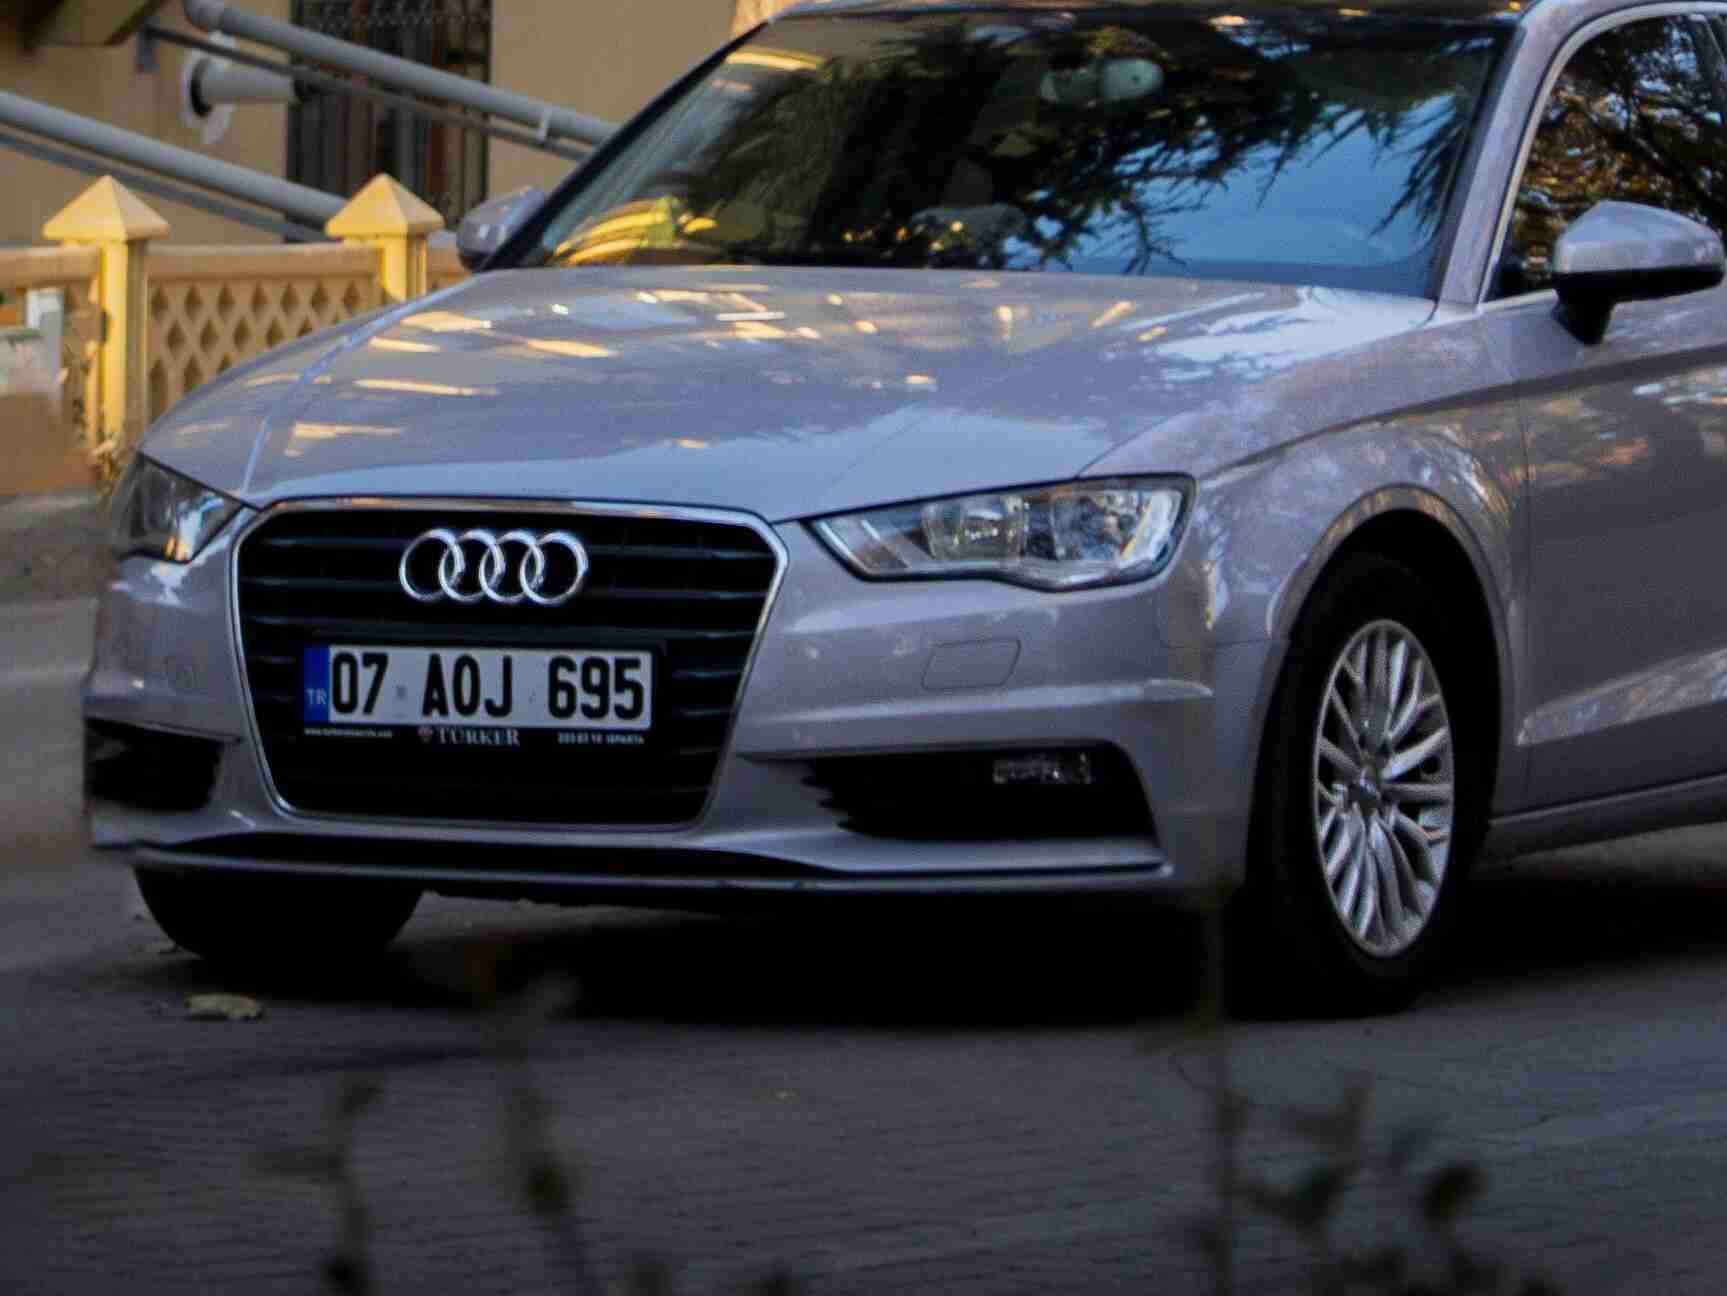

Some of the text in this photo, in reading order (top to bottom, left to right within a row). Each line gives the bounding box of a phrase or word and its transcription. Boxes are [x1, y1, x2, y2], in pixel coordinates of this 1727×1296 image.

[307, 689, 327, 706] TR
[331, 652, 645, 721] 07 AOJ 695
